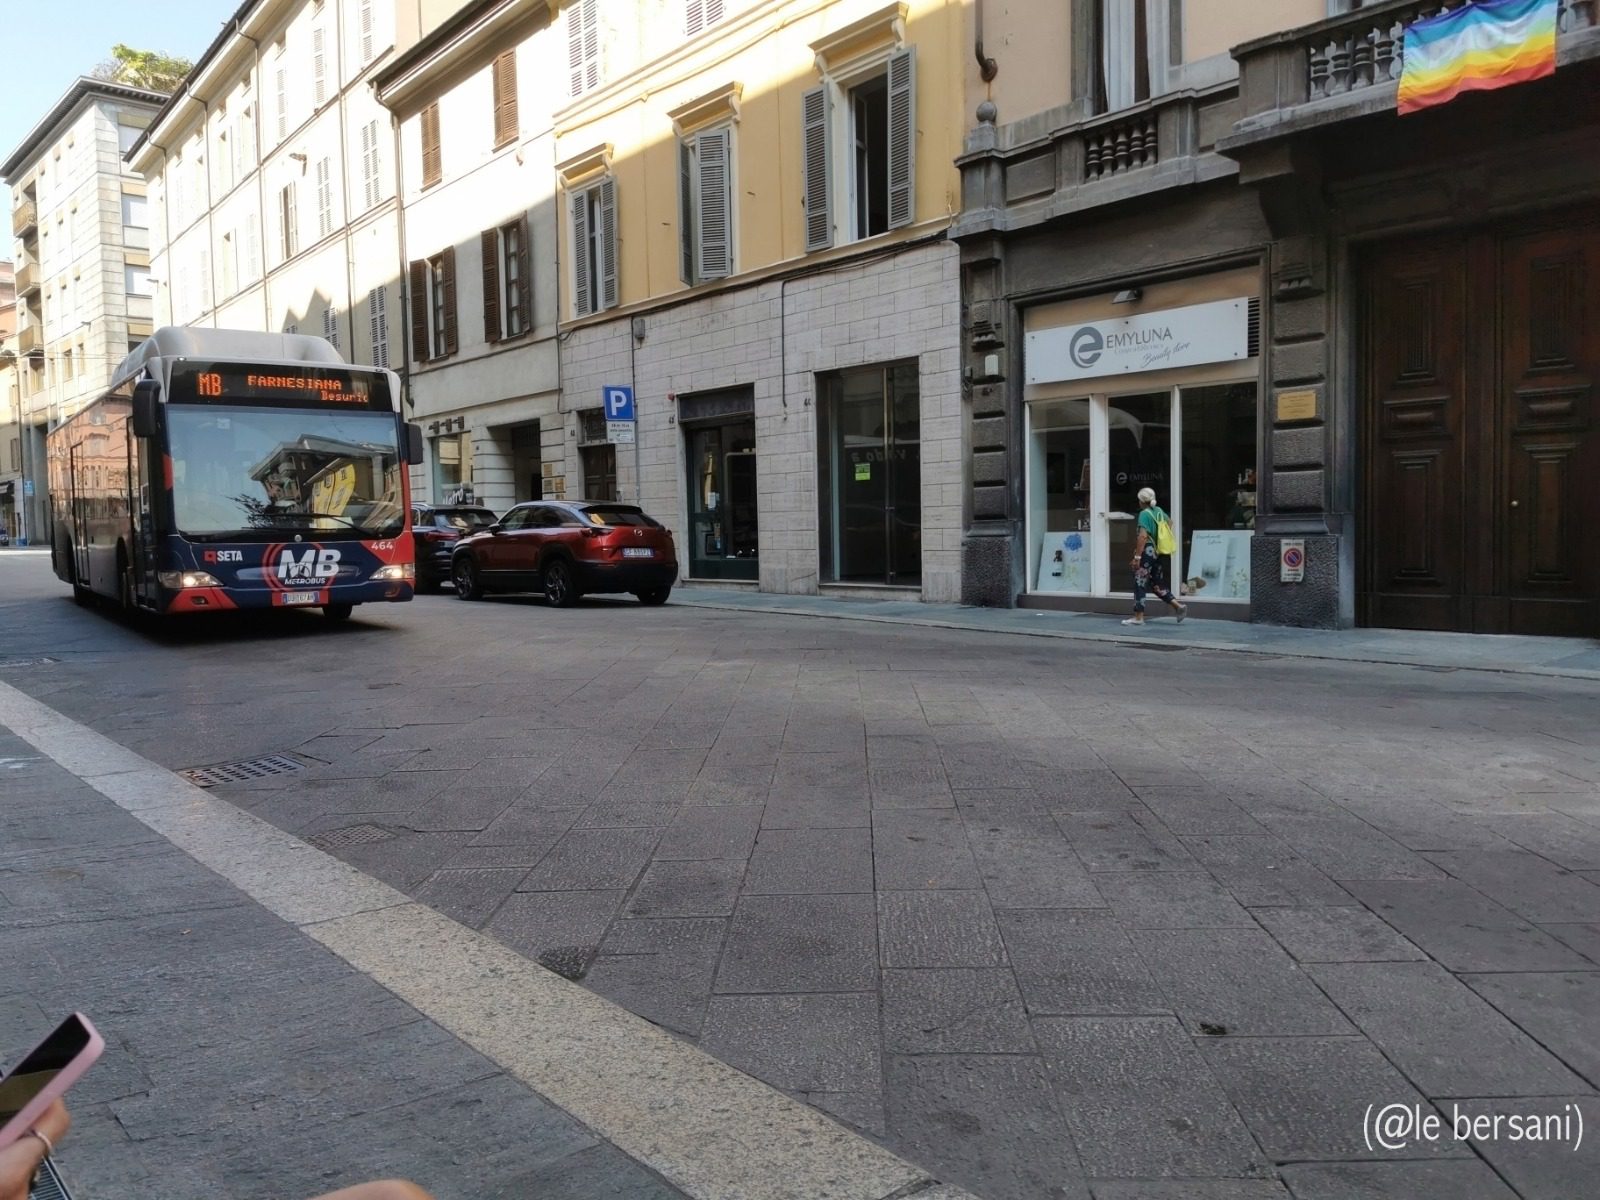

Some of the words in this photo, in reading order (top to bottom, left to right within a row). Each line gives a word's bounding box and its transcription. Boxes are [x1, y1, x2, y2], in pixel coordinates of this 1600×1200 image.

[1106, 326, 1173, 349] EMYLUNA
[197, 372, 223, 397] MB
[247, 375, 343, 390] FARNESIANA
[609, 390, 627, 416] P
[216, 550, 243, 562] SETA
[371, 541, 394, 551] 464
[277, 549, 342, 578] MB
[284, 577, 326, 586] METROBUS
